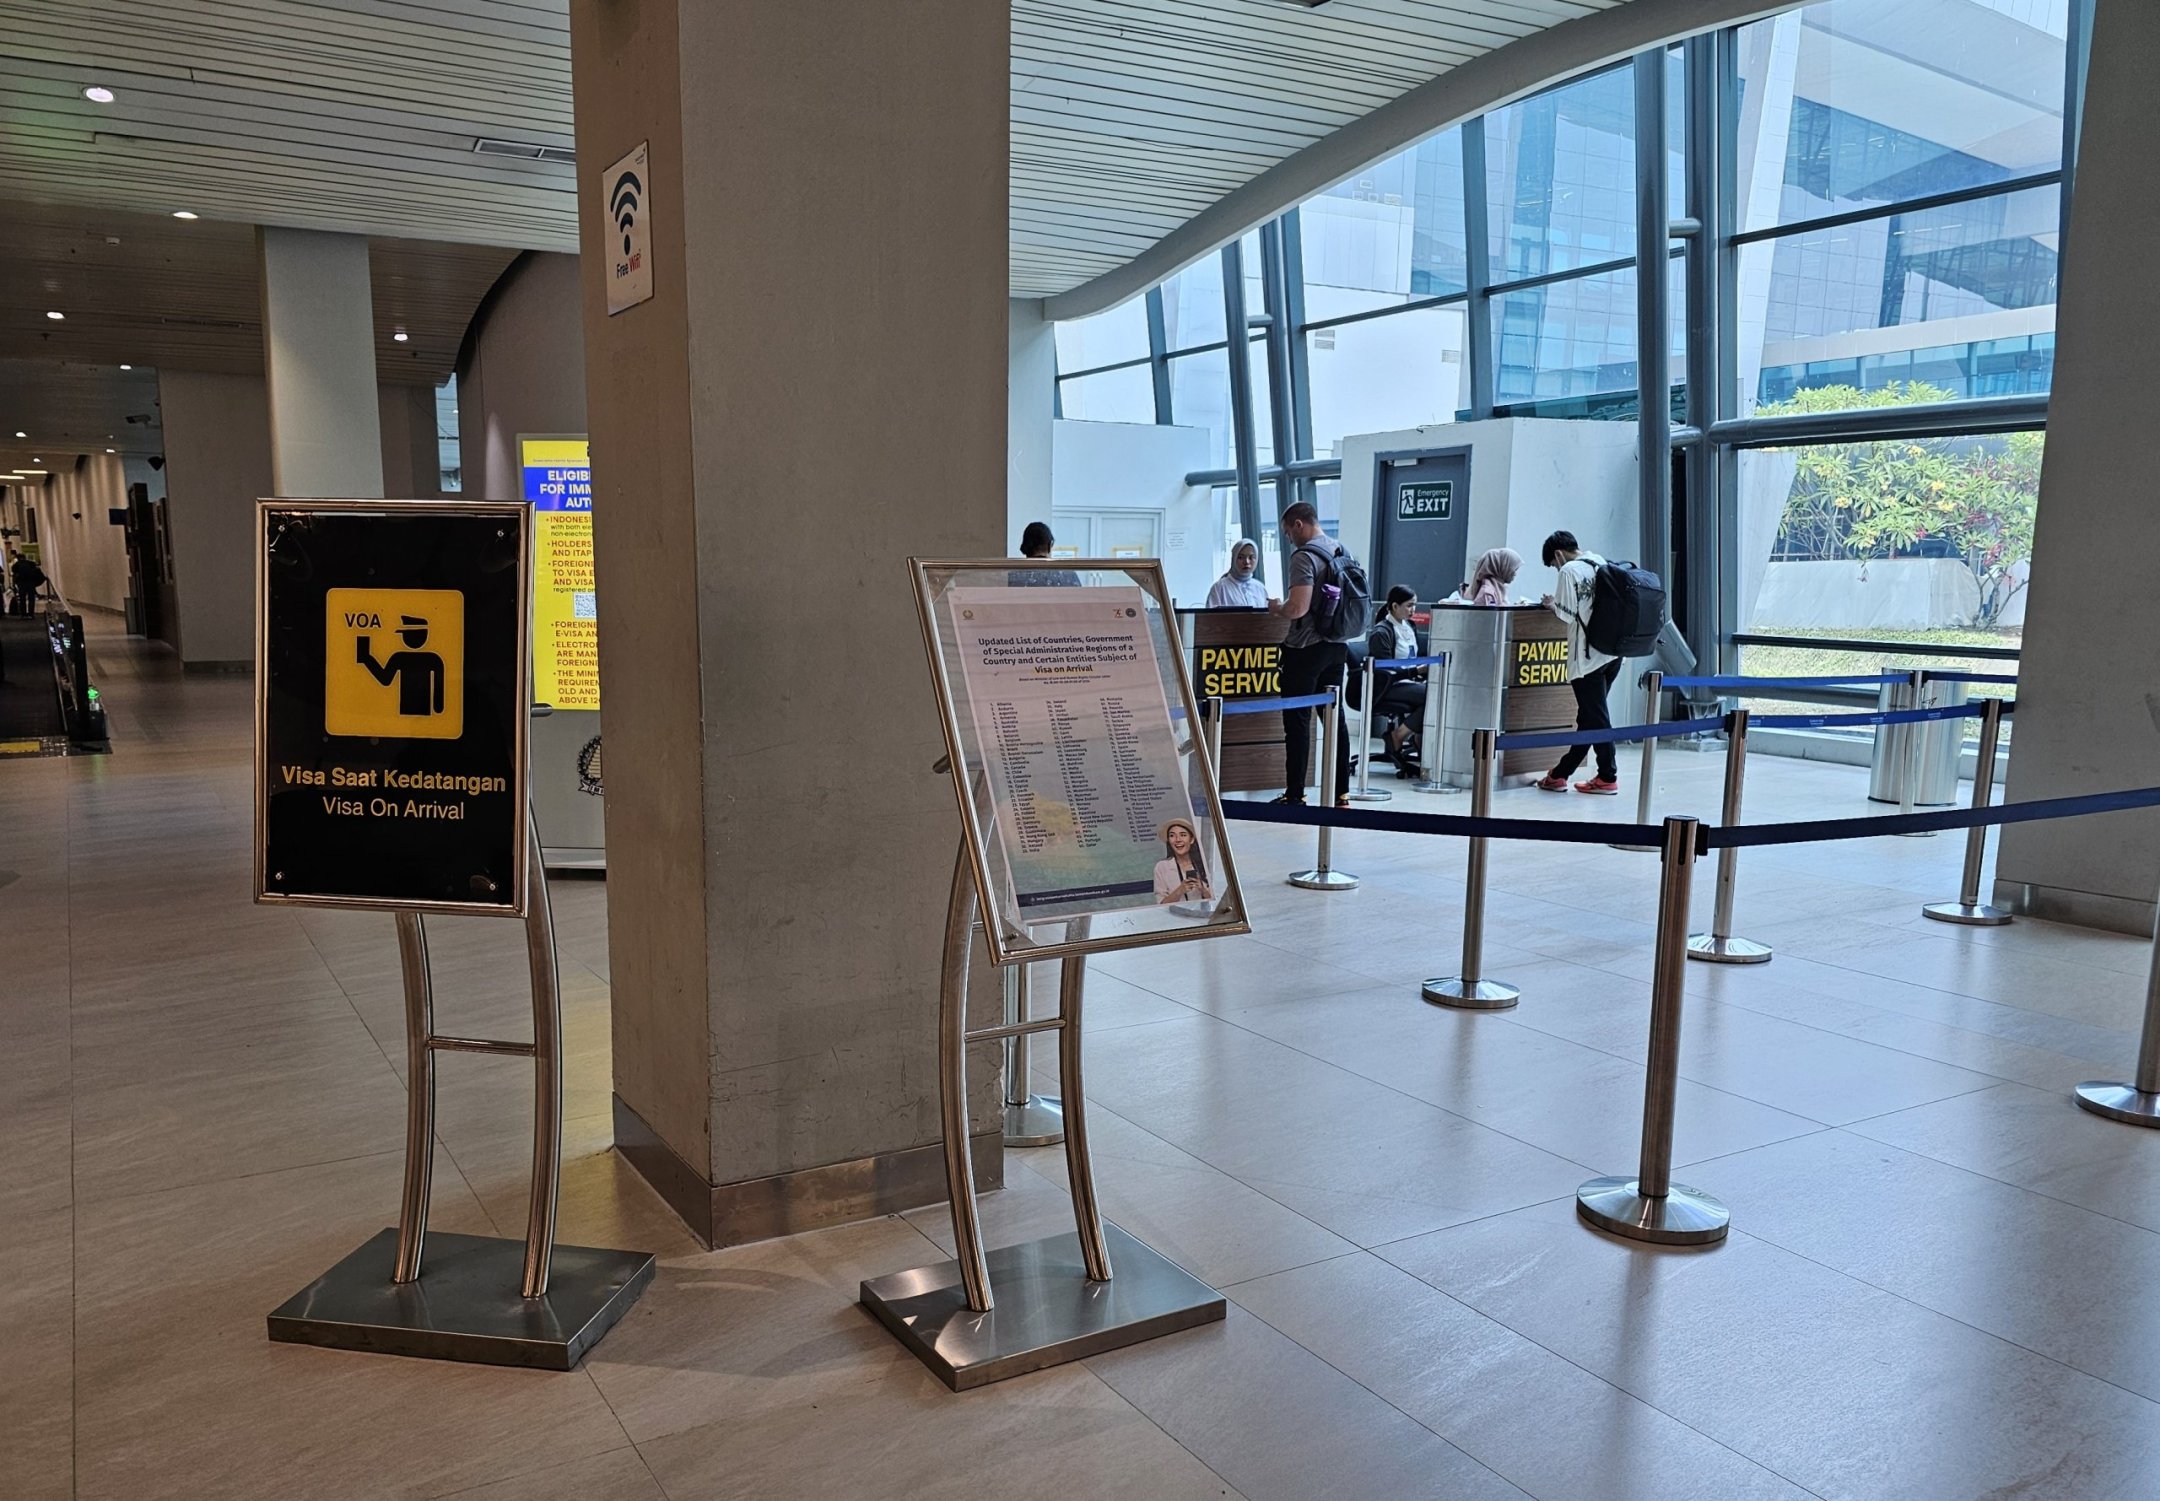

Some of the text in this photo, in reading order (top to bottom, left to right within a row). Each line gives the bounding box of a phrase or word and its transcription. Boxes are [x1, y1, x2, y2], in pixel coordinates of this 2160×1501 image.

[617, 263, 629, 280] Free
[540, 484, 565, 495] FOR
[1417, 498, 1449, 512] EXIT
[552, 540, 592, 548] HOLDERS
[344, 612, 382, 629] VOA
[978, 637, 1014, 646] Updated
[1016, 637, 1032, 645] List
[1033, 636, 1043, 644] of
[1086, 635, 1134, 643] Government
[983, 647, 992, 656] of
[994, 646, 1025, 656] Special
[1025, 645, 1084, 655] Administrative
[1086, 645, 1117, 654] Regions
[1119, 644, 1127, 652] of
[1518, 641, 1568, 662] PAYME
[983, 653, 1137, 666] Country and Certain Entities Subject of
[1035, 666, 1052, 674] Visa
[1066, 665, 1093, 673] Arrival
[282, 765, 506, 796] Visa Saat Kedatangan
[322, 796, 465, 820] Visa On Arrival
